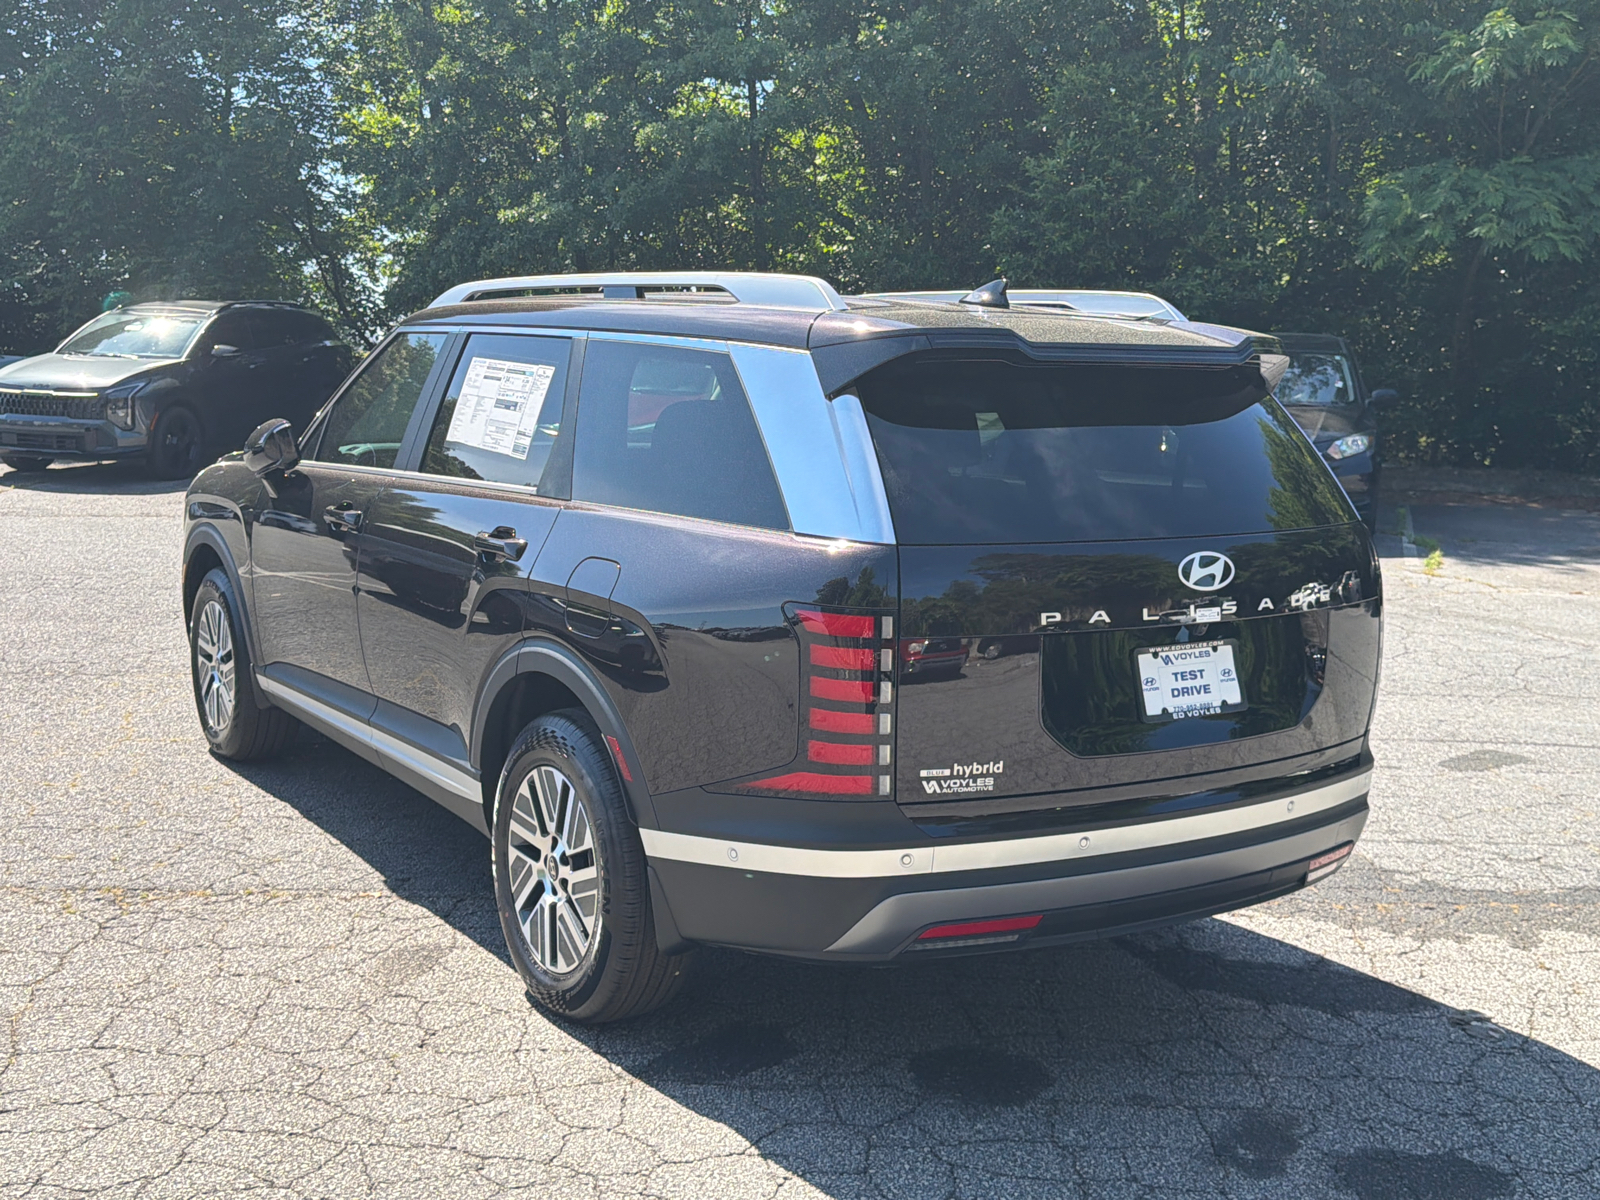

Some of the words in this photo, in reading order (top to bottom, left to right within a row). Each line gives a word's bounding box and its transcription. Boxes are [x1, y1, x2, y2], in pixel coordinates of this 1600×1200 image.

[1040, 588, 1331, 626] PALISADE
[1173, 650, 1211, 661] VOYLES
[1172, 669, 1205, 682] TEST
[1171, 684, 1212, 698] DRIVE
[1172, 711, 1185, 720] ED
[1186, 706, 1222, 718] VOYLES
[953, 760, 1004, 778] hybrid
[940, 777, 994, 788] VOYLES
[941, 785, 994, 793] AUTOMOTIVE
